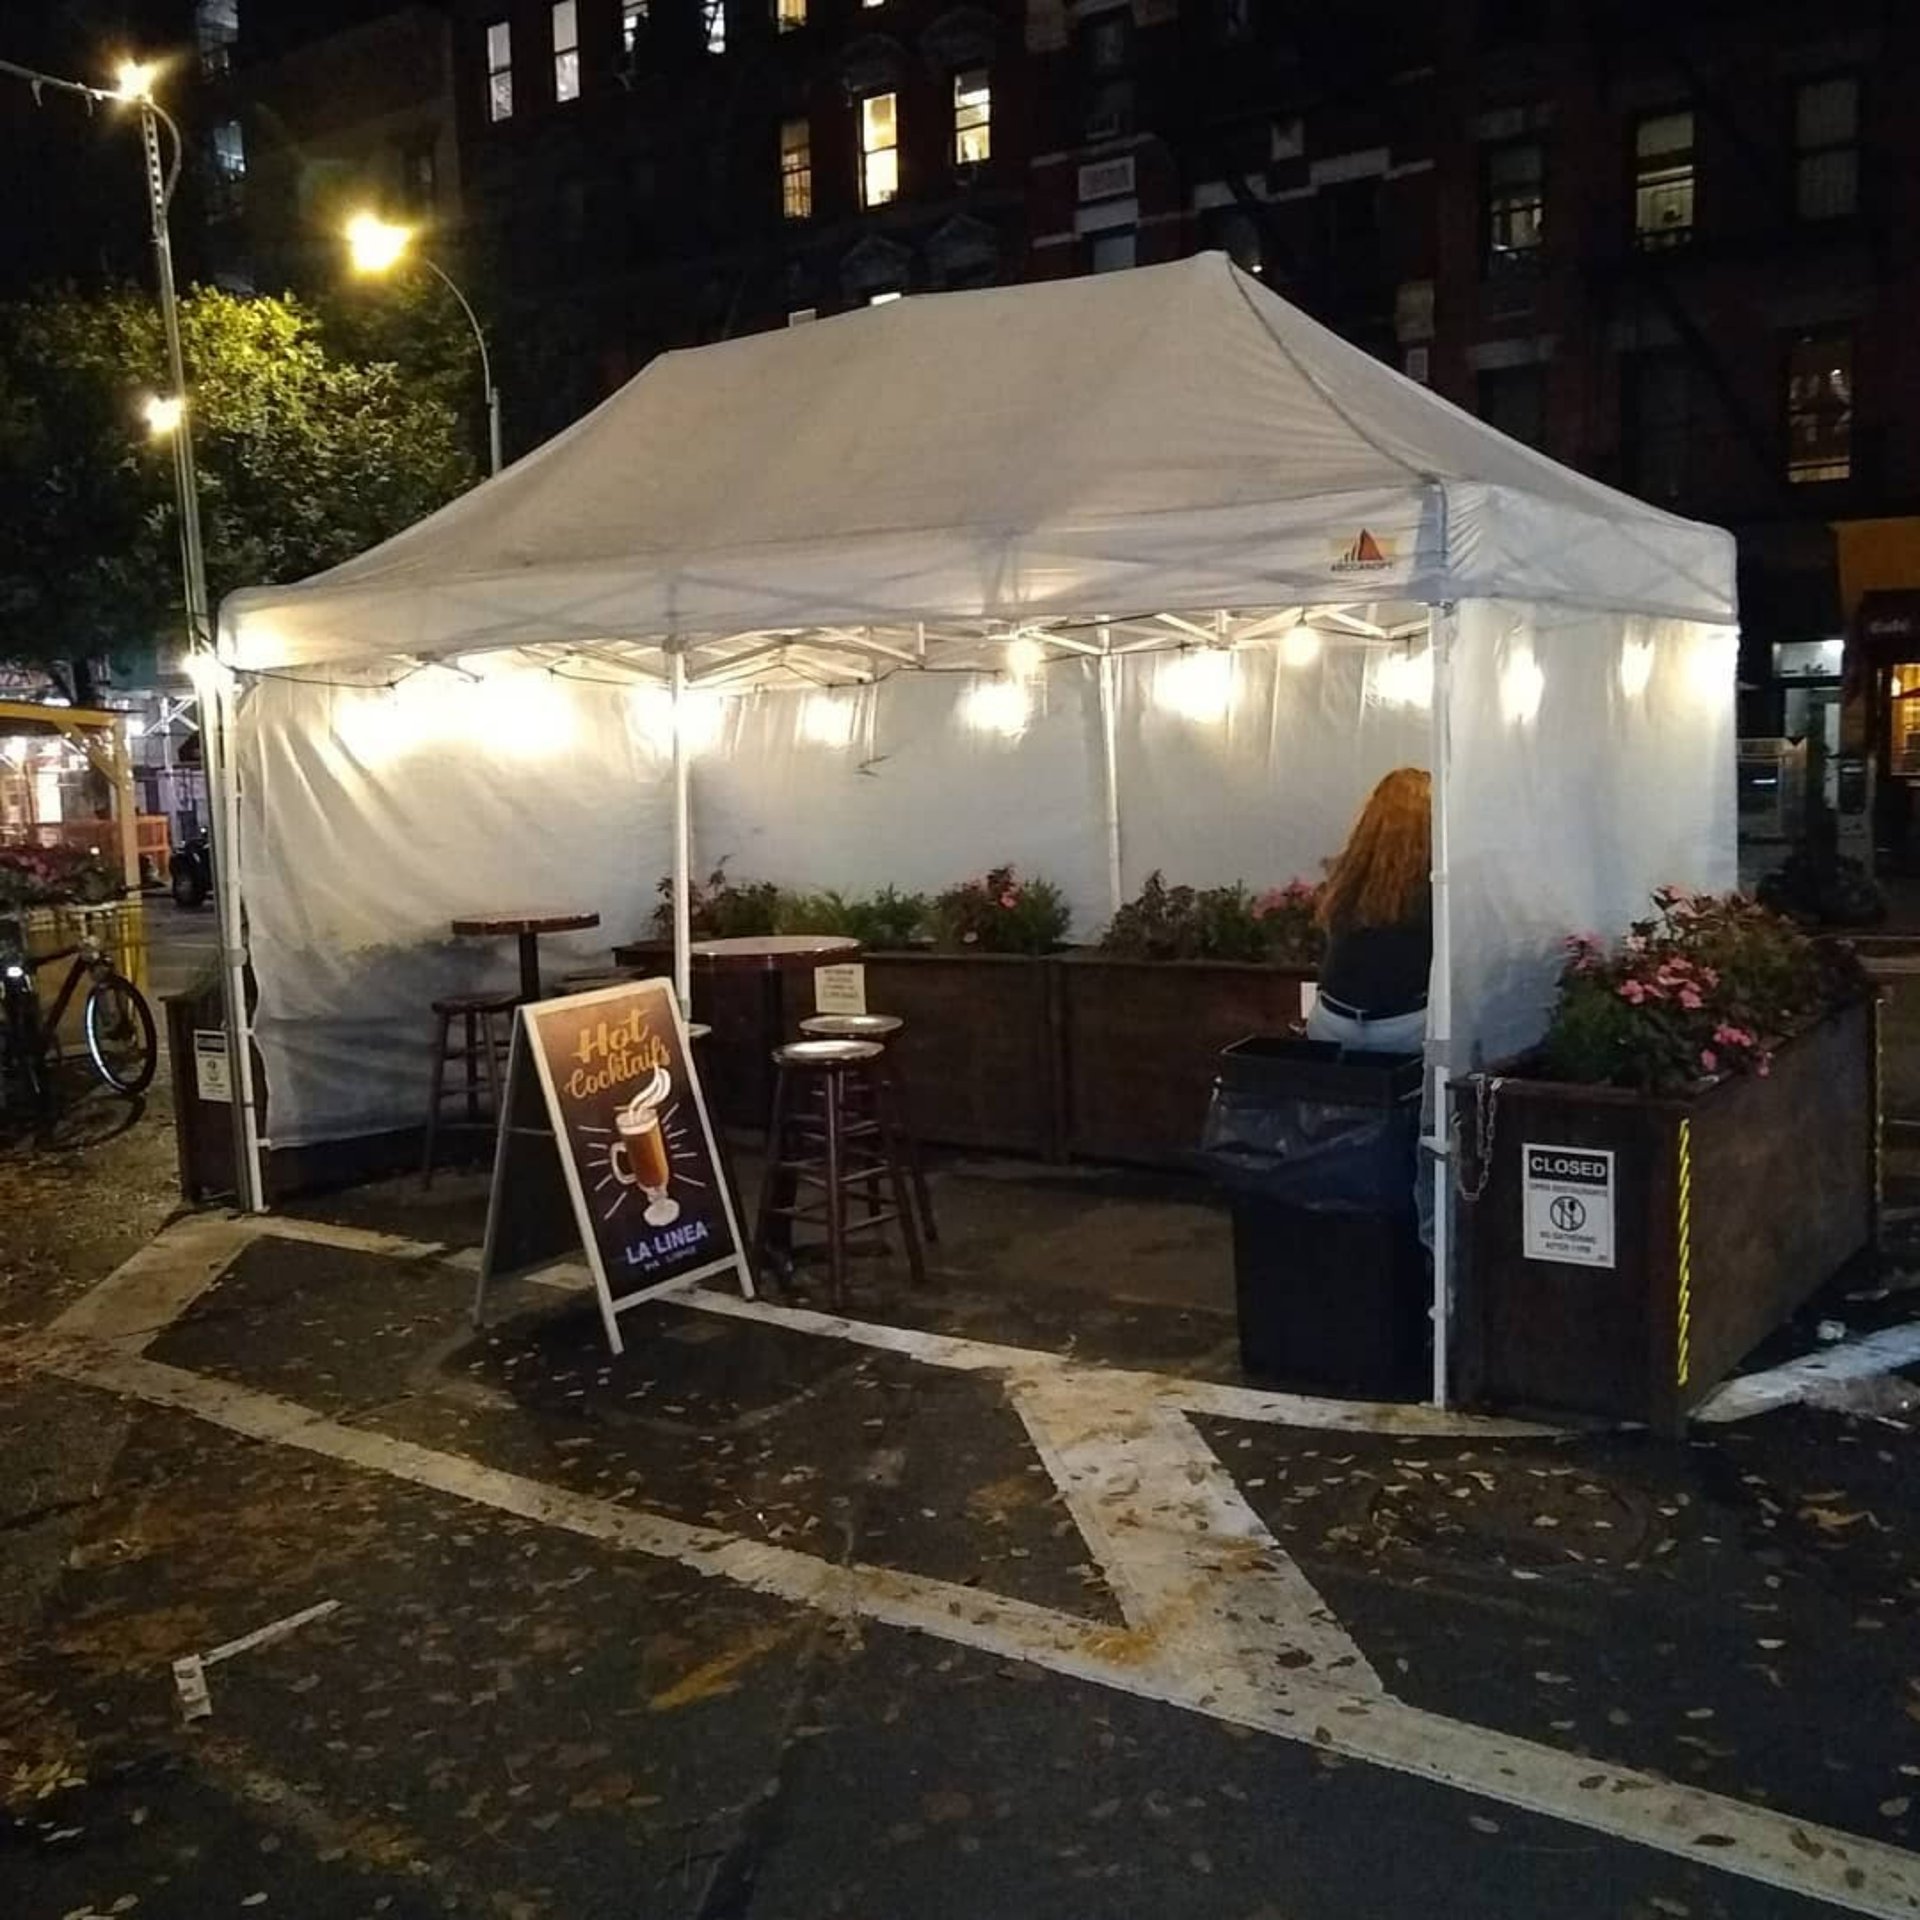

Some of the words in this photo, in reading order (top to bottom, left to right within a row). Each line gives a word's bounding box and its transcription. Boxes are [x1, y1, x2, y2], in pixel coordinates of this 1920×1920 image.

[571, 1008, 649, 1063] Hot
[563, 1035, 671, 1098] Cocktails
[1530, 1156, 1606, 1178] CLOSED
[625, 1240, 652, 1265] LA
[654, 1220, 708, 1254] LINEA
